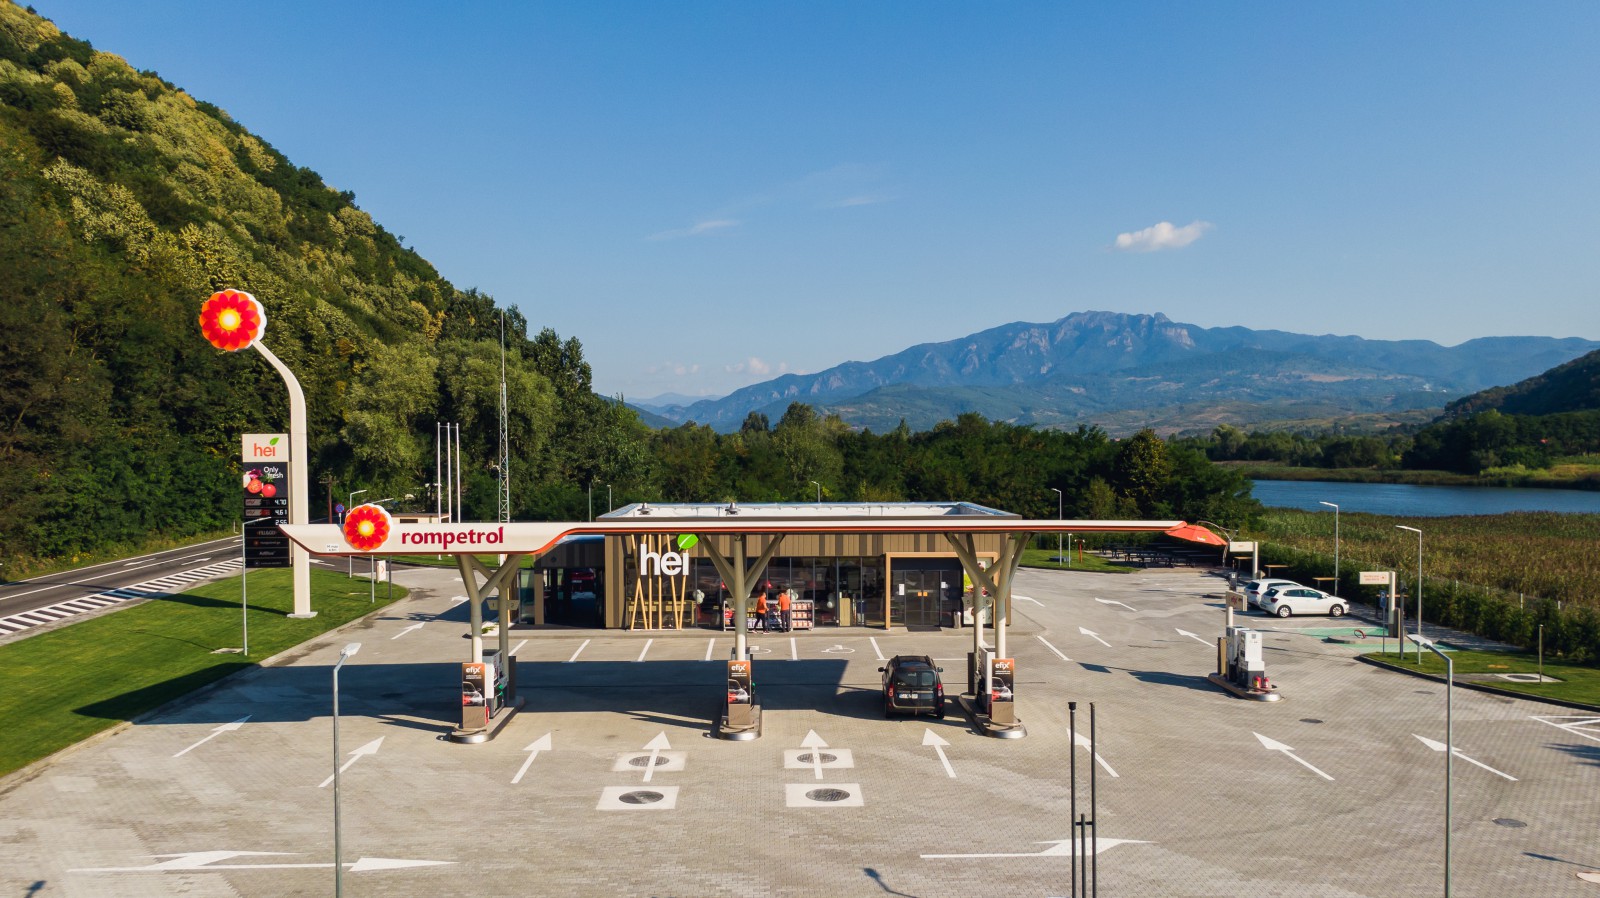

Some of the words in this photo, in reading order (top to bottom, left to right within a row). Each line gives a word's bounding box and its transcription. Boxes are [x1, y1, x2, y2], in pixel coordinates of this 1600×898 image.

[254, 438, 278, 457] hei
[263, 466, 279, 474] Only
[402, 526, 504, 550] rompetrol
[641, 535, 697, 576] hei
[731, 664, 746, 672] efix
[995, 661, 1010, 669] efix
[466, 666, 481, 674] efix
